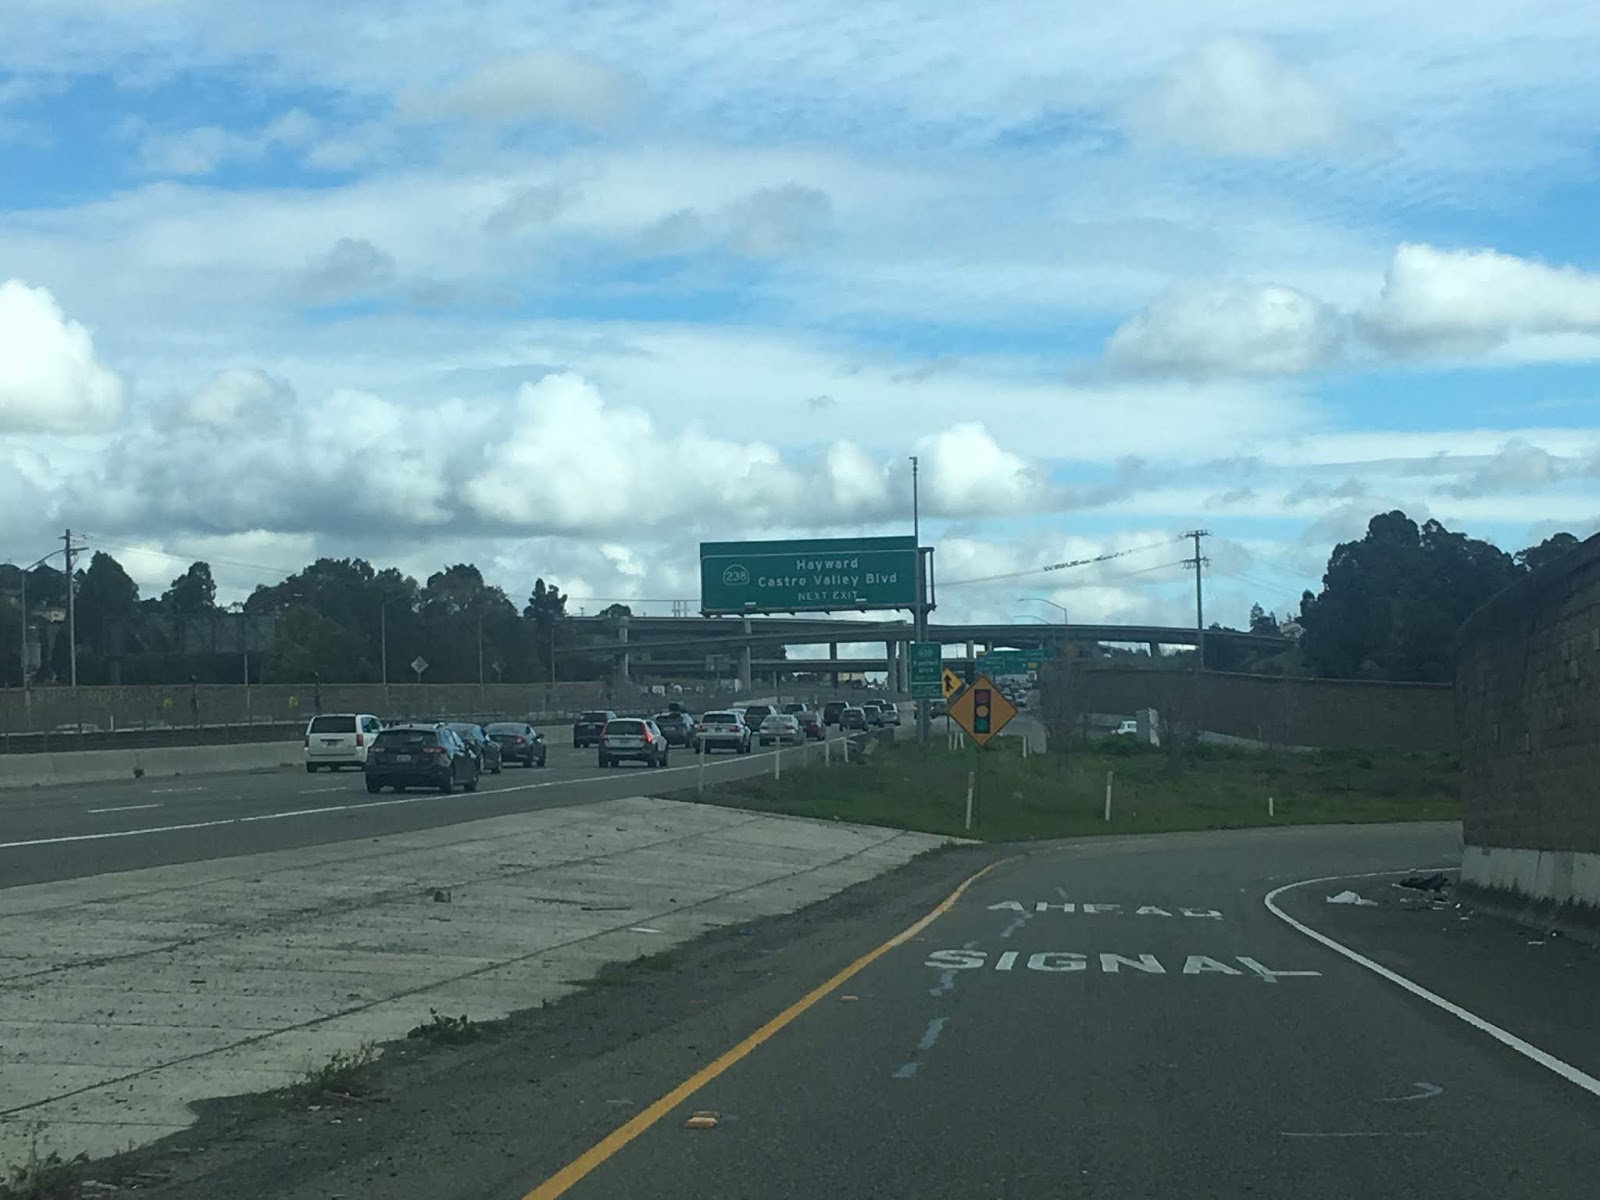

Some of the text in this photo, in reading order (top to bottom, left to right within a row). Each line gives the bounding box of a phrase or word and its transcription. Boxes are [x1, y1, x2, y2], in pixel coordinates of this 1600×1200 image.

[796, 558, 859, 572] Hayward
[726, 571, 747, 582] 238
[758, 572, 898, 588] Castro Valley Blvd
[797, 590, 859, 601] NEXT EXIT
[987, 899, 1224, 921] AHEAD
[924, 949, 1323, 980] SIGNAL
